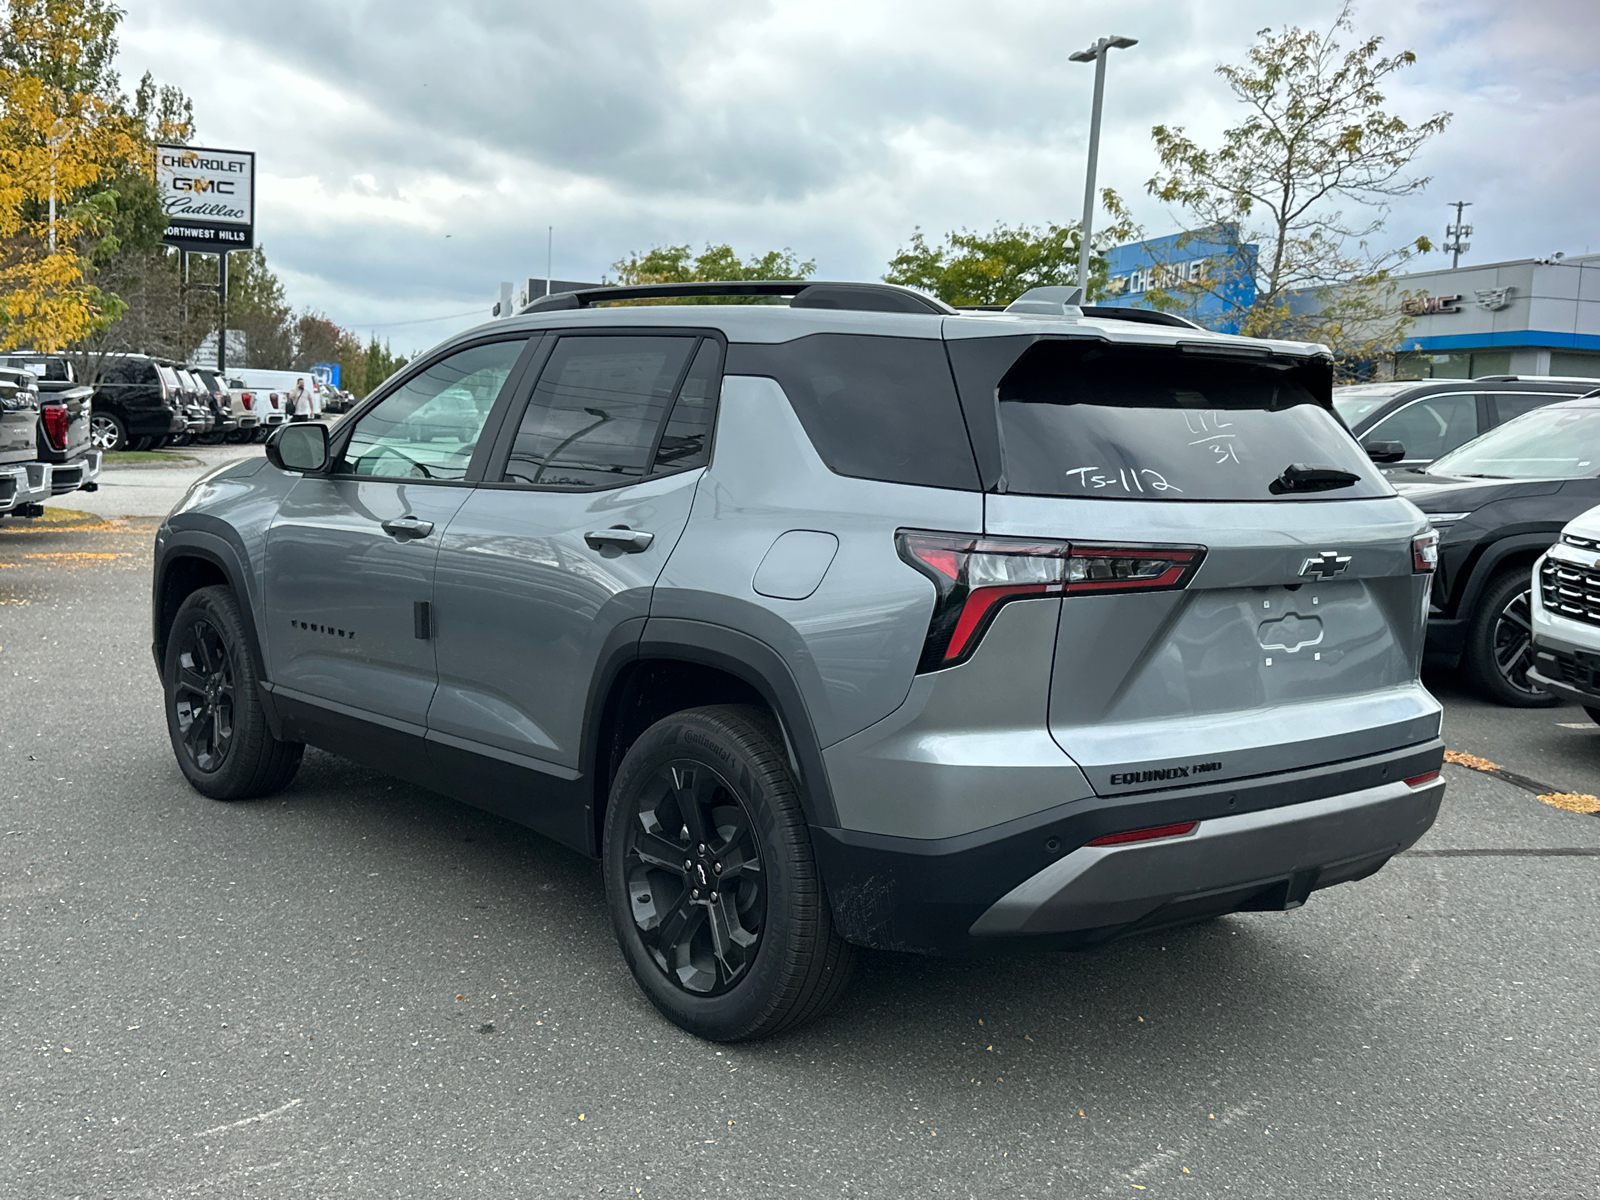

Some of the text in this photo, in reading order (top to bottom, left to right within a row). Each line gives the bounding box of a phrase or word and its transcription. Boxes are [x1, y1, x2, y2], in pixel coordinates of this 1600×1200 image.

[162, 155, 246, 173] CHEVROLET
[173, 177, 234, 195] GMC
[162, 196, 244, 218] Cadillac
[163, 226, 245, 241] ORTHWEST HILLS
[1401, 294, 1462, 315] GMC
[684, 729, 732, 763] Continental
[1110, 766, 1189, 785] EQUINOX
